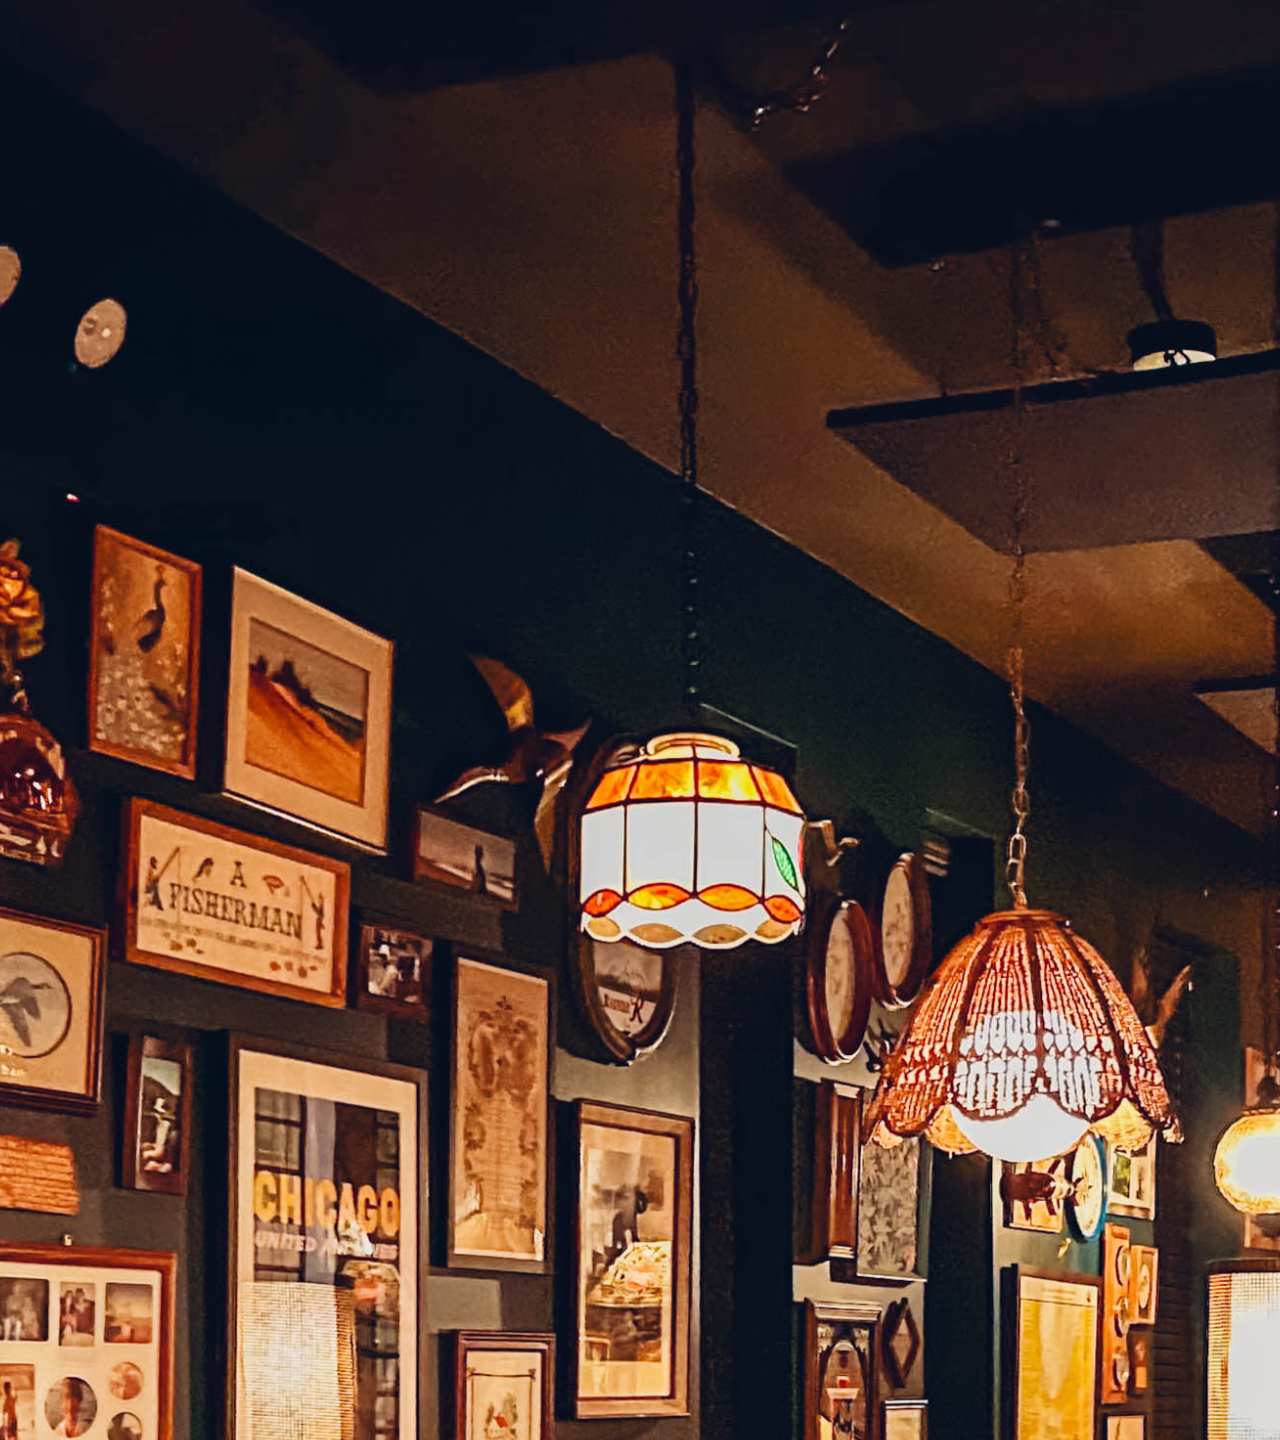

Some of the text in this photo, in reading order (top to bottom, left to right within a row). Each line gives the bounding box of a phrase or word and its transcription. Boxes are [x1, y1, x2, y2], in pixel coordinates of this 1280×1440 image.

[230, 861, 247, 889] A
[169, 883, 303, 941] FISHERMAN
[253, 1170, 401, 1237] CHICAGO
